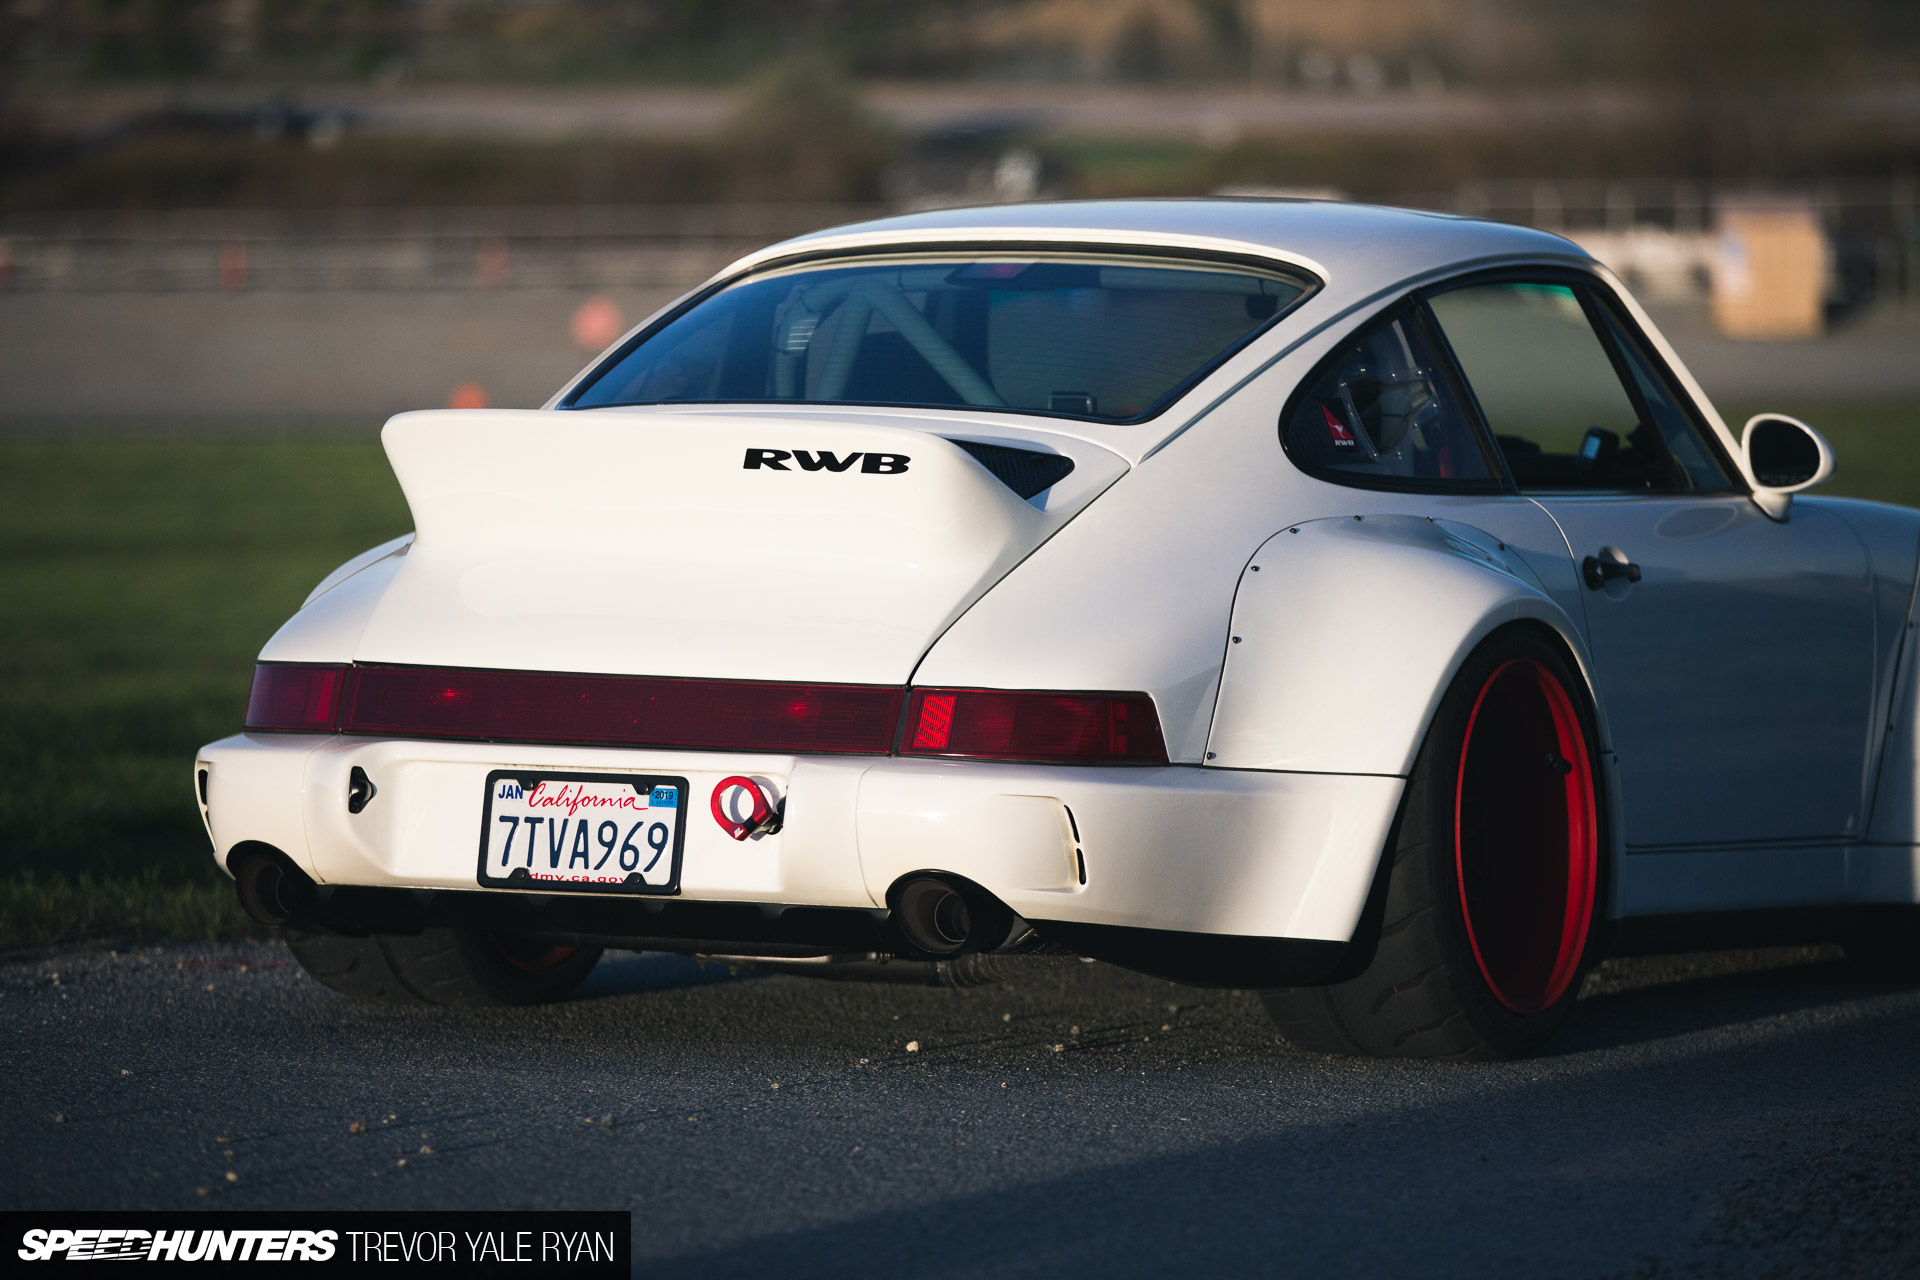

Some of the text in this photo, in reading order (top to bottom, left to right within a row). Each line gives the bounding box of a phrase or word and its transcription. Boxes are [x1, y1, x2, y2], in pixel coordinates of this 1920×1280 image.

[743, 448, 911, 474] RWB
[498, 784, 523, 799] JAN
[528, 782, 648, 816] California
[654, 790, 674, 800] 2019
[499, 815, 669, 873] 7TVA969
